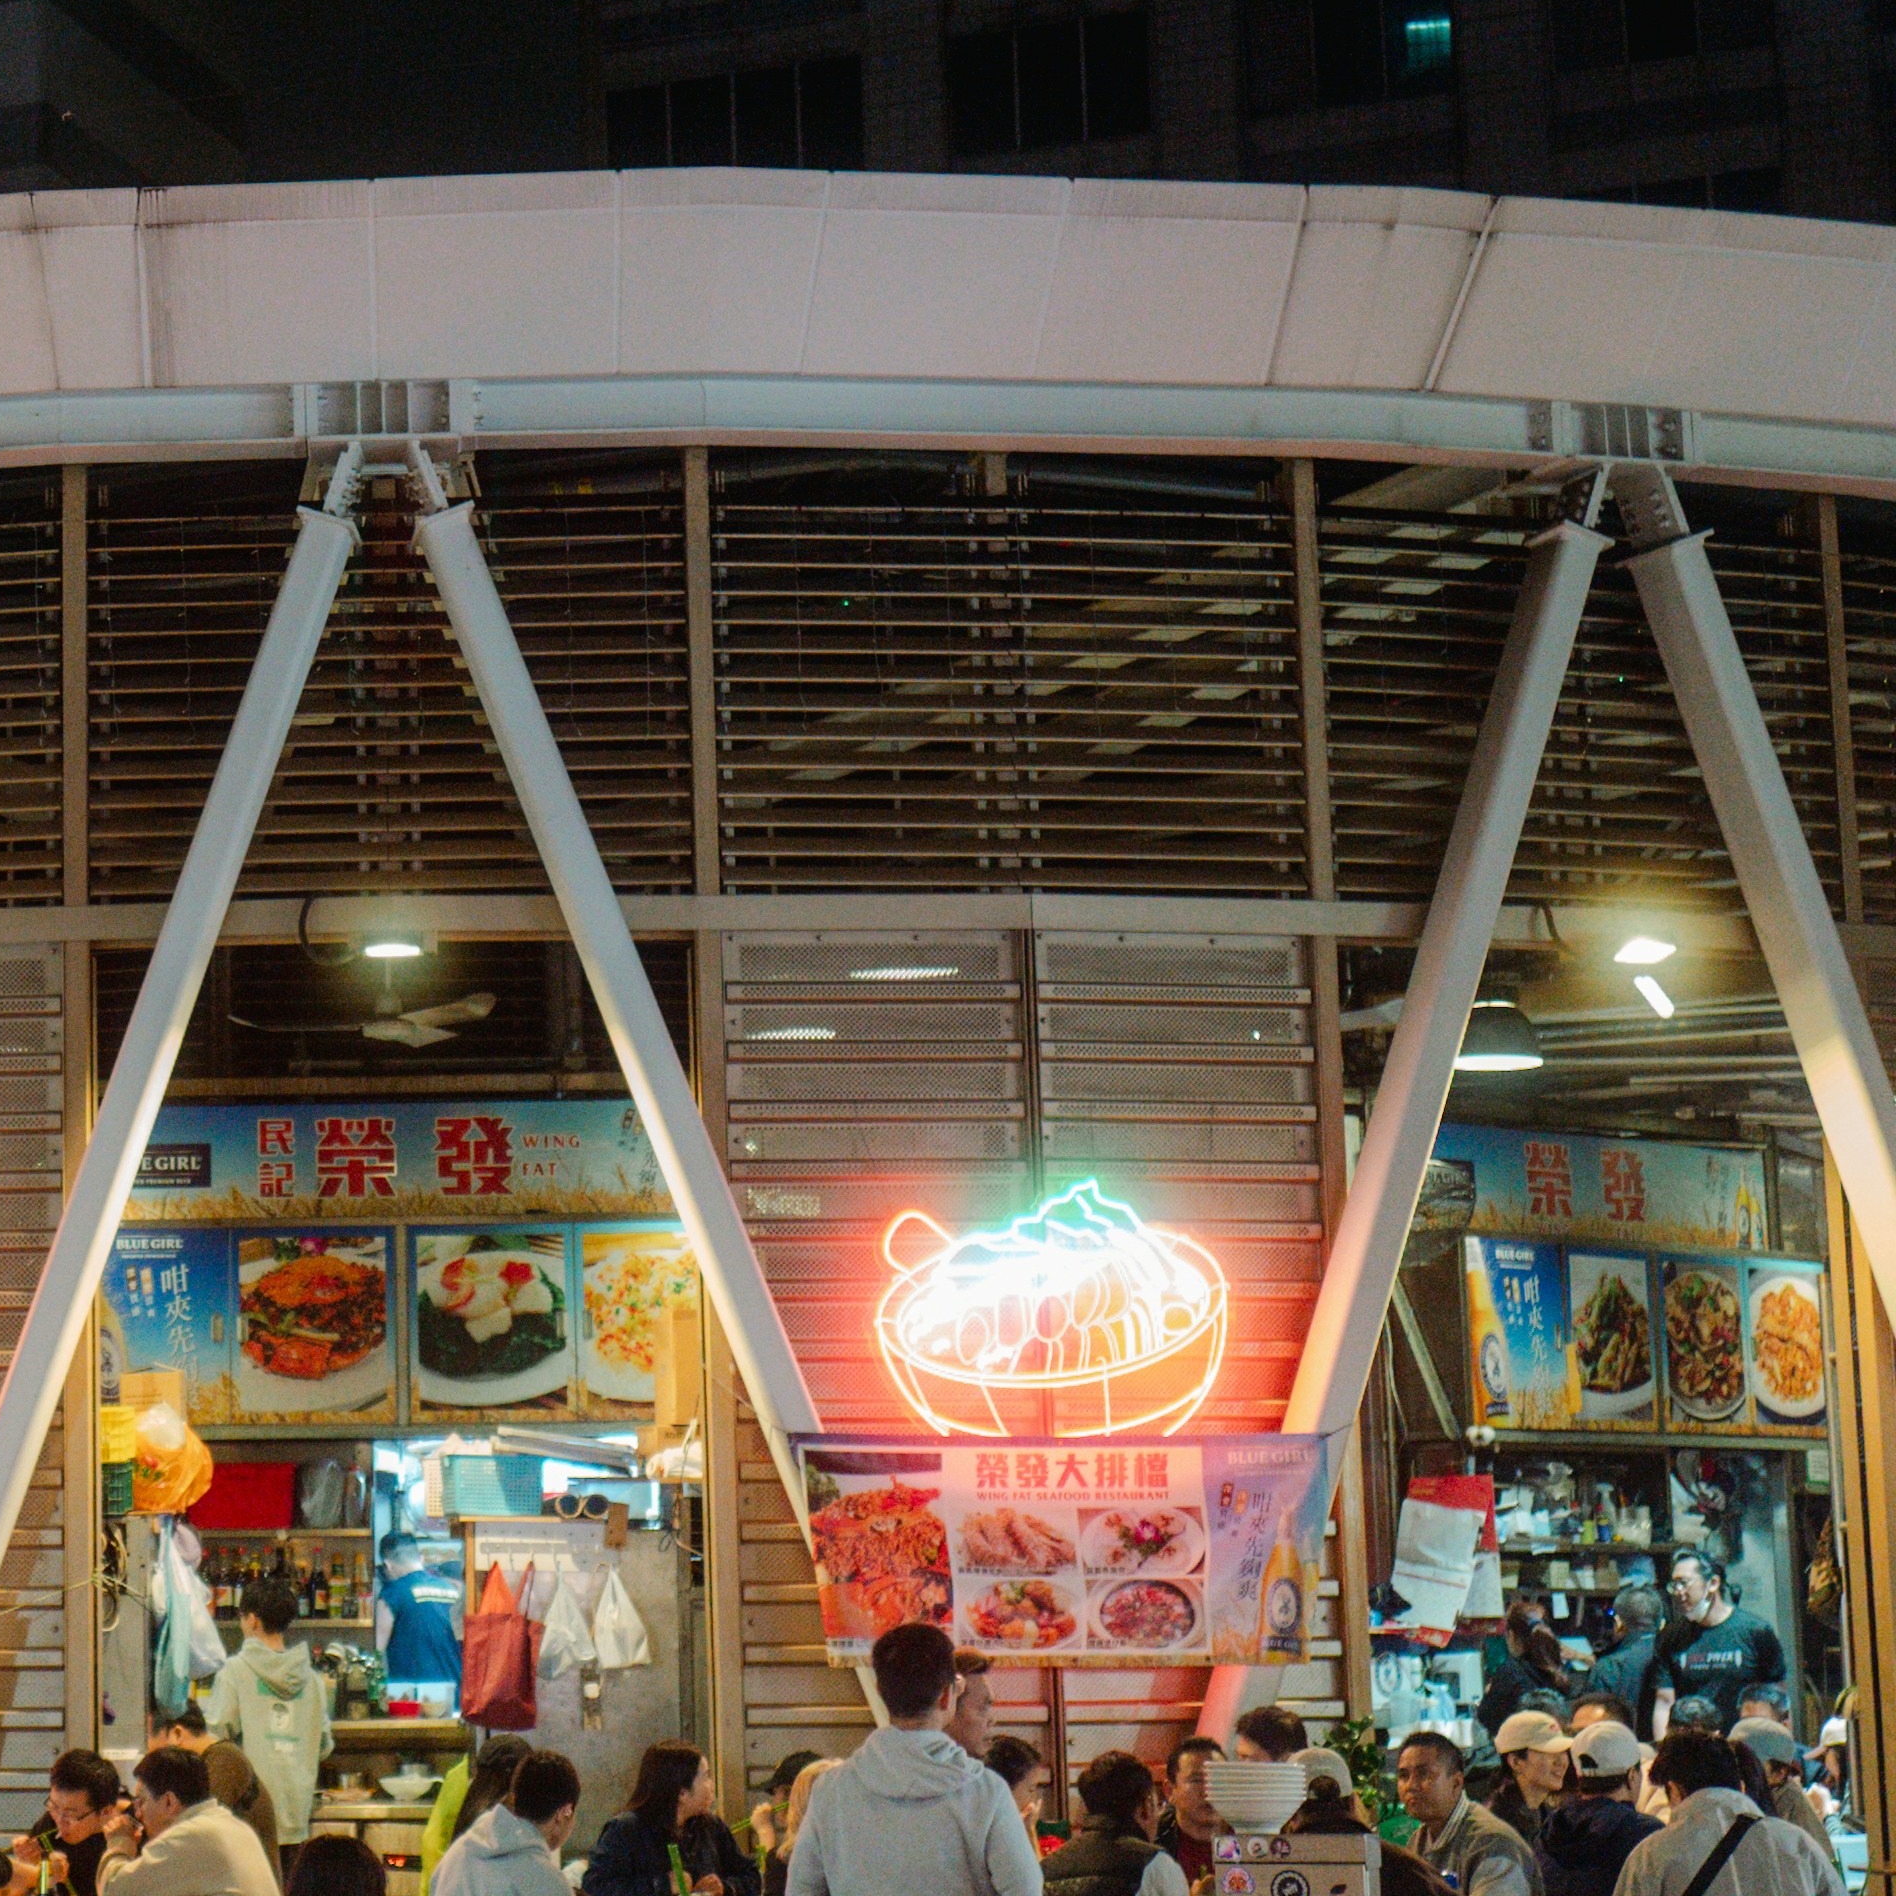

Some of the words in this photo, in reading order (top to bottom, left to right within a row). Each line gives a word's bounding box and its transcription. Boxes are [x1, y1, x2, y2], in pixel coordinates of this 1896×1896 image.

[521, 1134, 581, 1149] WING
[154, 1156, 202, 1171] GIRL
[258, 1119, 294, 1197] 民記
[315, 1117, 514, 1197] 榮發
[522, 1162, 558, 1176] FAT
[1524, 1141, 1646, 1222] 榮發
[116, 1238, 151, 1250] BLUE
[151, 1238, 184, 1250] GIRL
[1228, 1451, 1265, 1465] BLUE
[1271, 1450, 1312, 1463] GIRL
[976, 1453, 1169, 1489] 榮發大排檔
[977, 1491, 1008, 1502] WING
[1012, 1491, 1031, 1502] FAT
[1036, 1491, 1091, 1502] SEAFOOD
[1095, 1491, 1169, 1501] RESTAURANT
